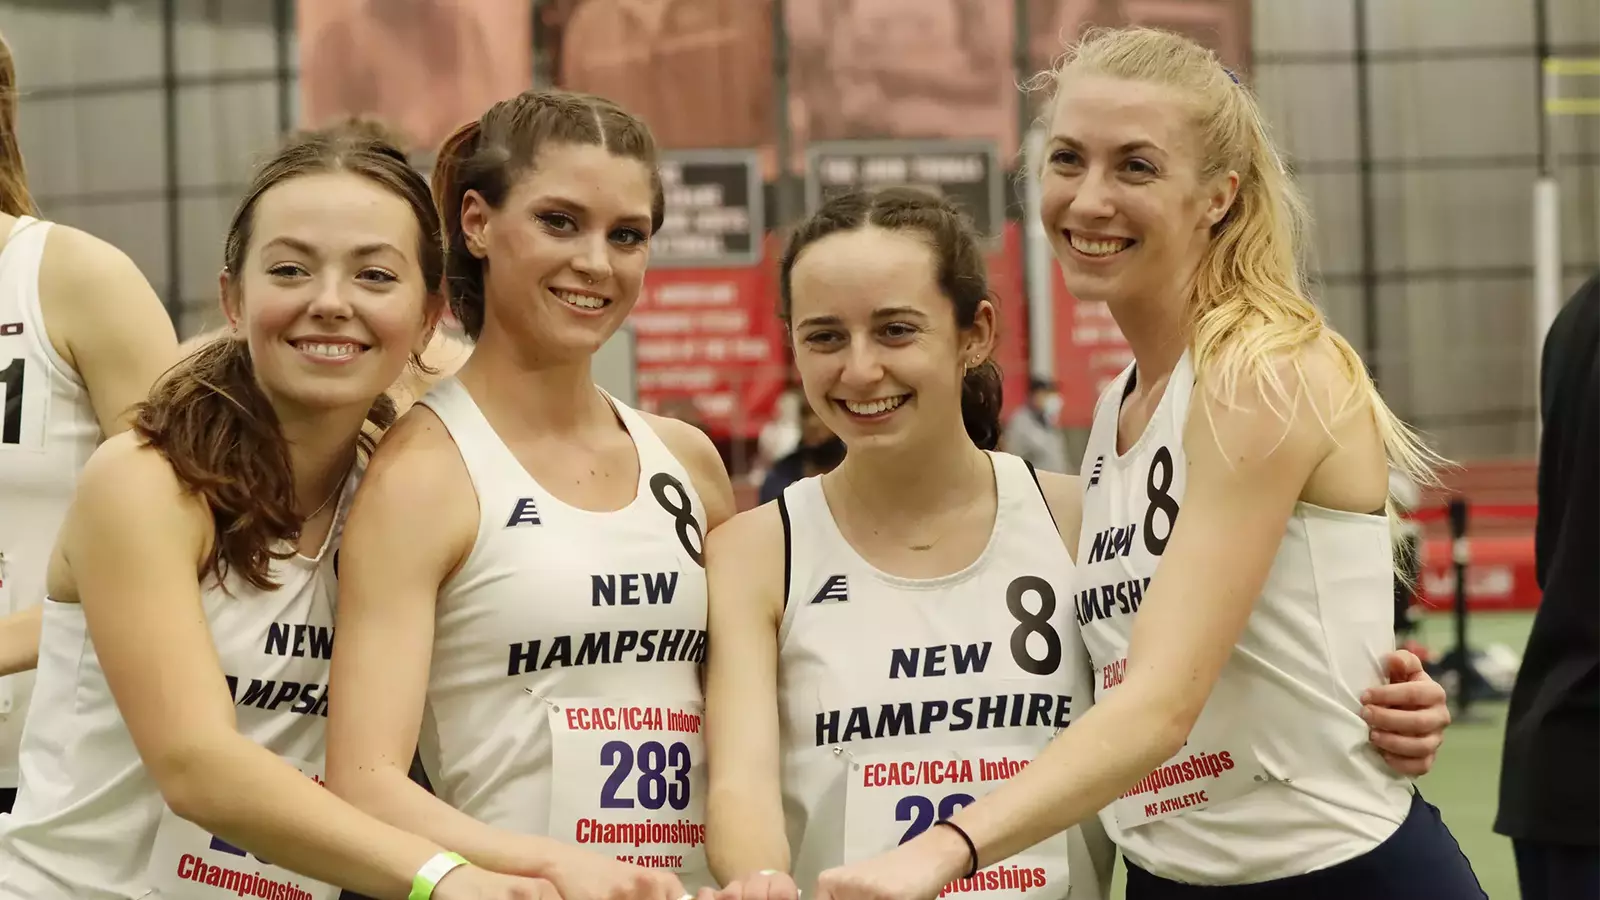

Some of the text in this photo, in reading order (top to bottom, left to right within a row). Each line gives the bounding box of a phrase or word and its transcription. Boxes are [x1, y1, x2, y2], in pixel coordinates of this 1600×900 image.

[1143, 446, 1180, 556] 8
[650, 472, 706, 569] 8
[591, 571, 679, 607] NEW
[264, 621, 336, 660] NEW
[1005, 575, 1062, 676] 8
[507, 629, 707, 677] HAMPSHIR
[888, 641, 993, 679] NEW
[565, 706, 701, 734] ECAC/IC4A Indoor
[815, 692, 1073, 747] HAMPSHIRE
[599, 740, 692, 811] 283
[863, 758, 974, 788] ECAC/IC4A
[1160, 789, 1209, 814] ATHLETIC
[575, 817, 706, 848] Championships
[636, 855, 683, 868] ATHLETIC
